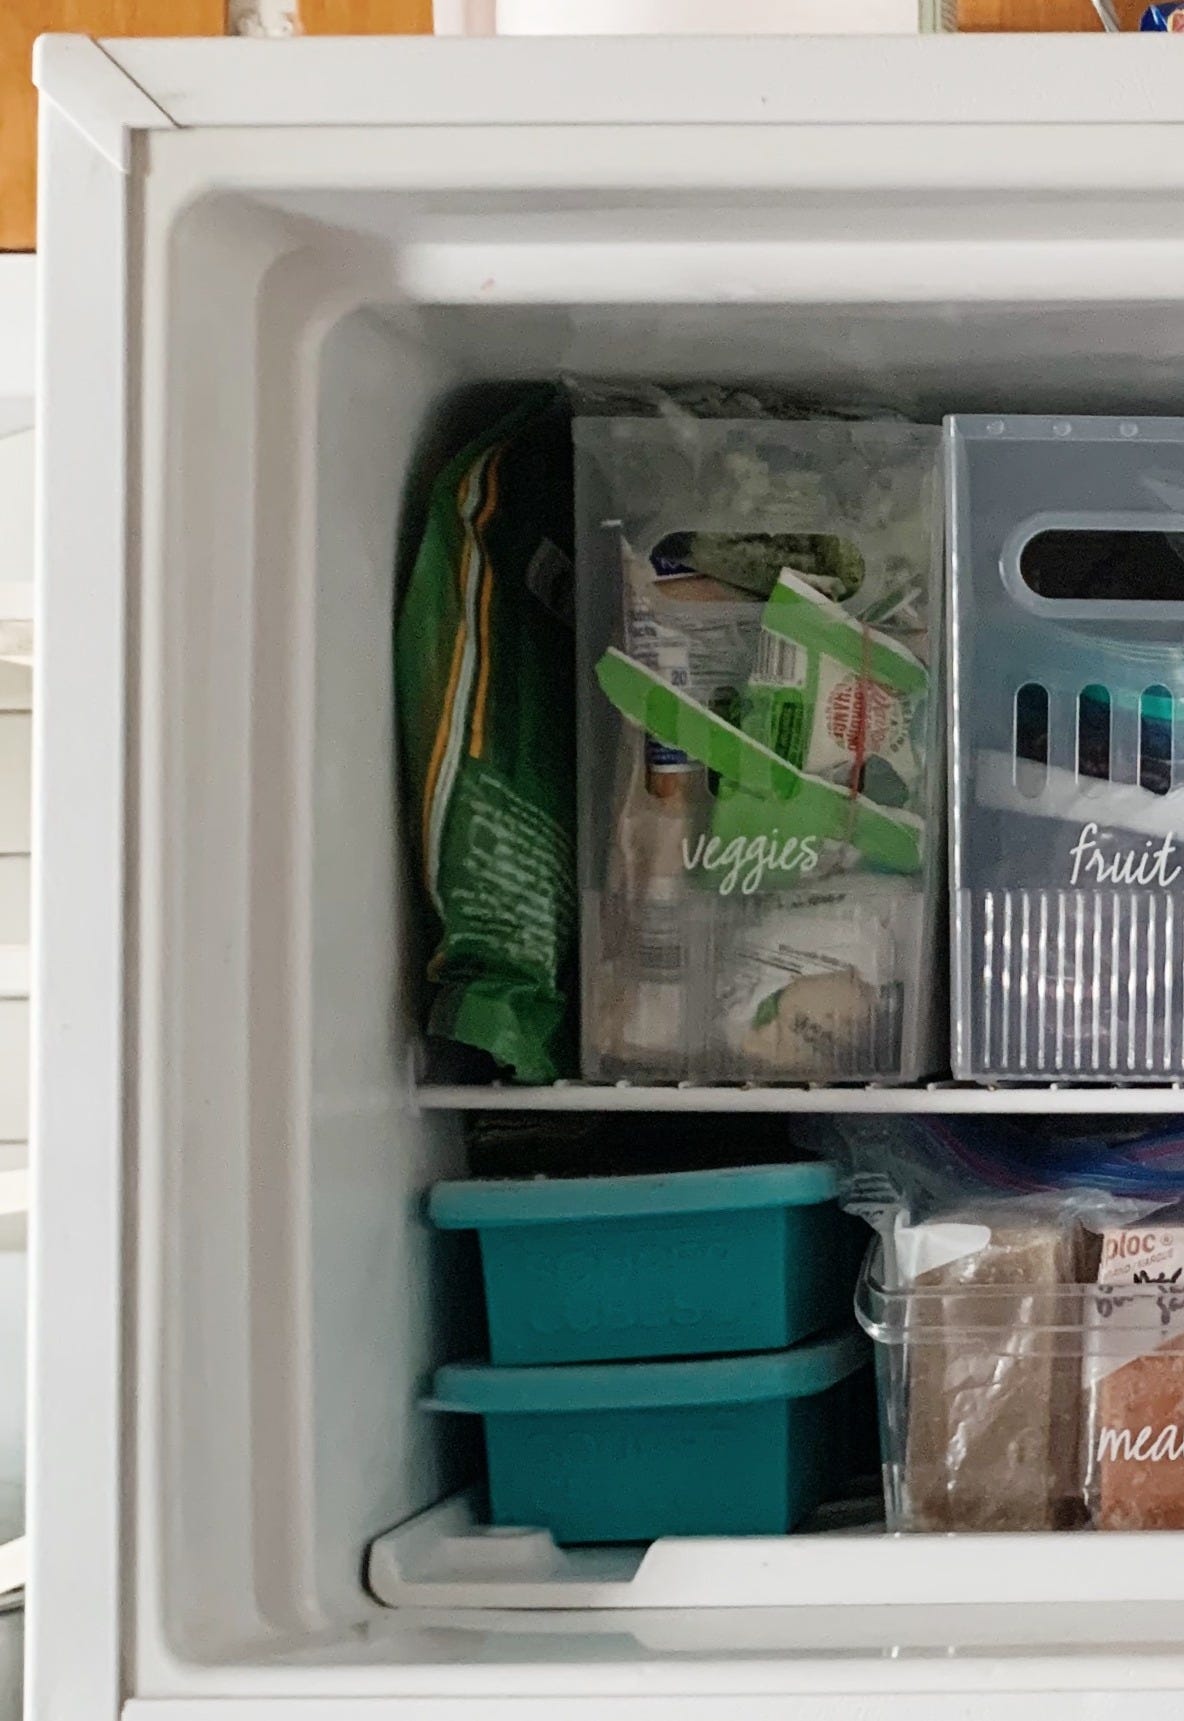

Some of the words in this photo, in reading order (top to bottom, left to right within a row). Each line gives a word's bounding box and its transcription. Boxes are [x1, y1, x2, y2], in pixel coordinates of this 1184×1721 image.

[682, 828, 819, 896] veggies
[1069, 822, 1182, 887] fruit
[1104, 1231, 1156, 1264] ploc
